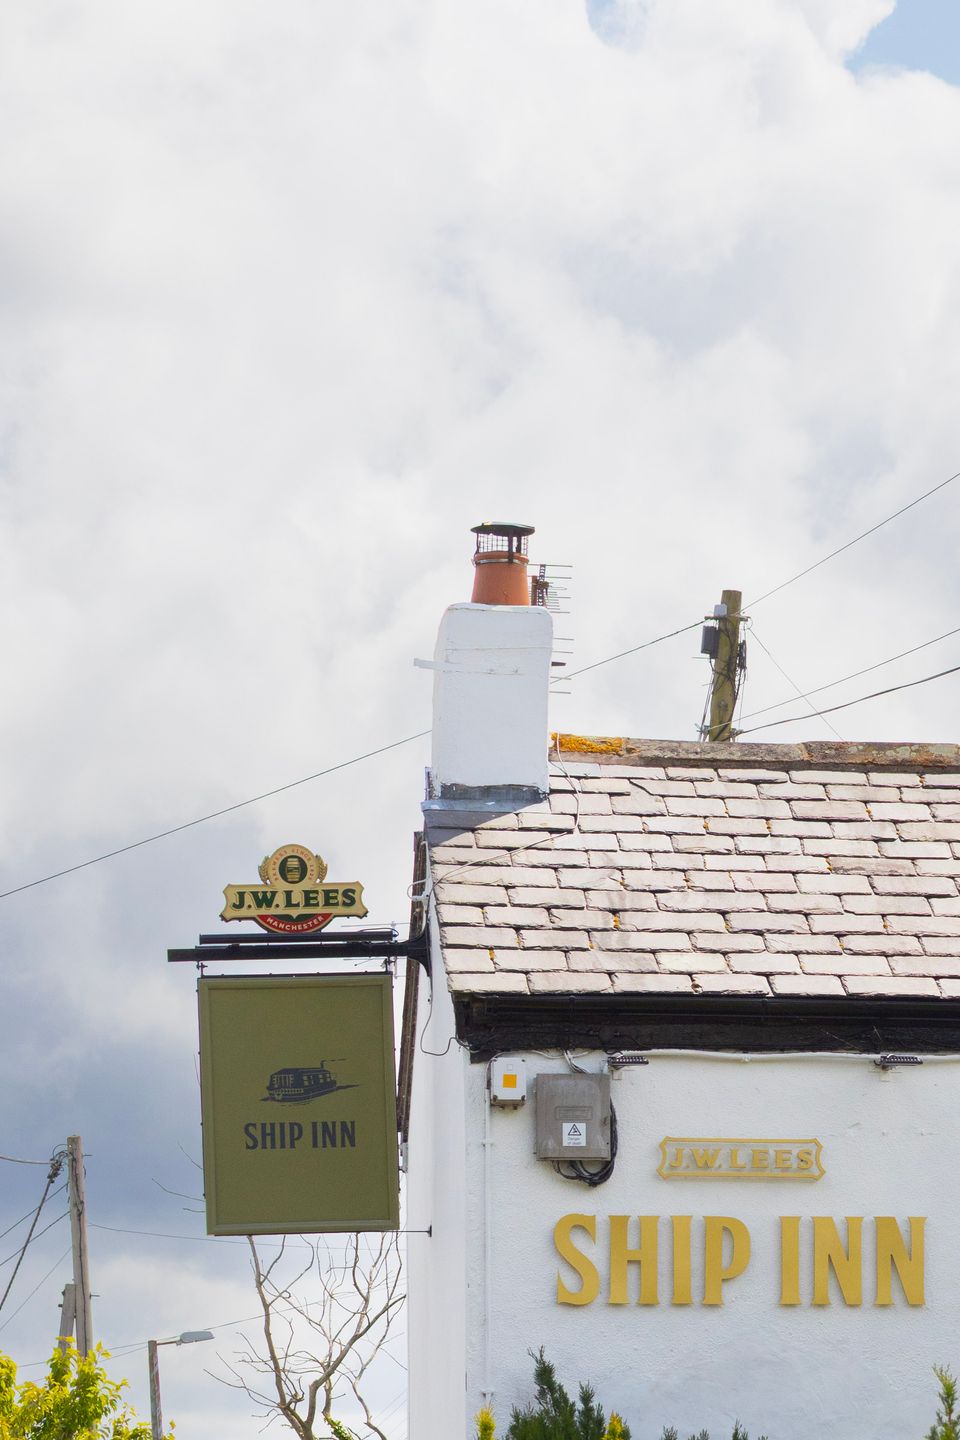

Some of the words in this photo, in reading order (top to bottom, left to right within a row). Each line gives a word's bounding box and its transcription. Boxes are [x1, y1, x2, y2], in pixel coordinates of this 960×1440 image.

[266, 915, 325, 932] MANCHESTER
[243, 1121, 304, 1150] SHIP
[311, 1120, 356, 1149] INN
[553, 1213, 751, 1306] SHIP
[779, 1216, 928, 1306] INN
